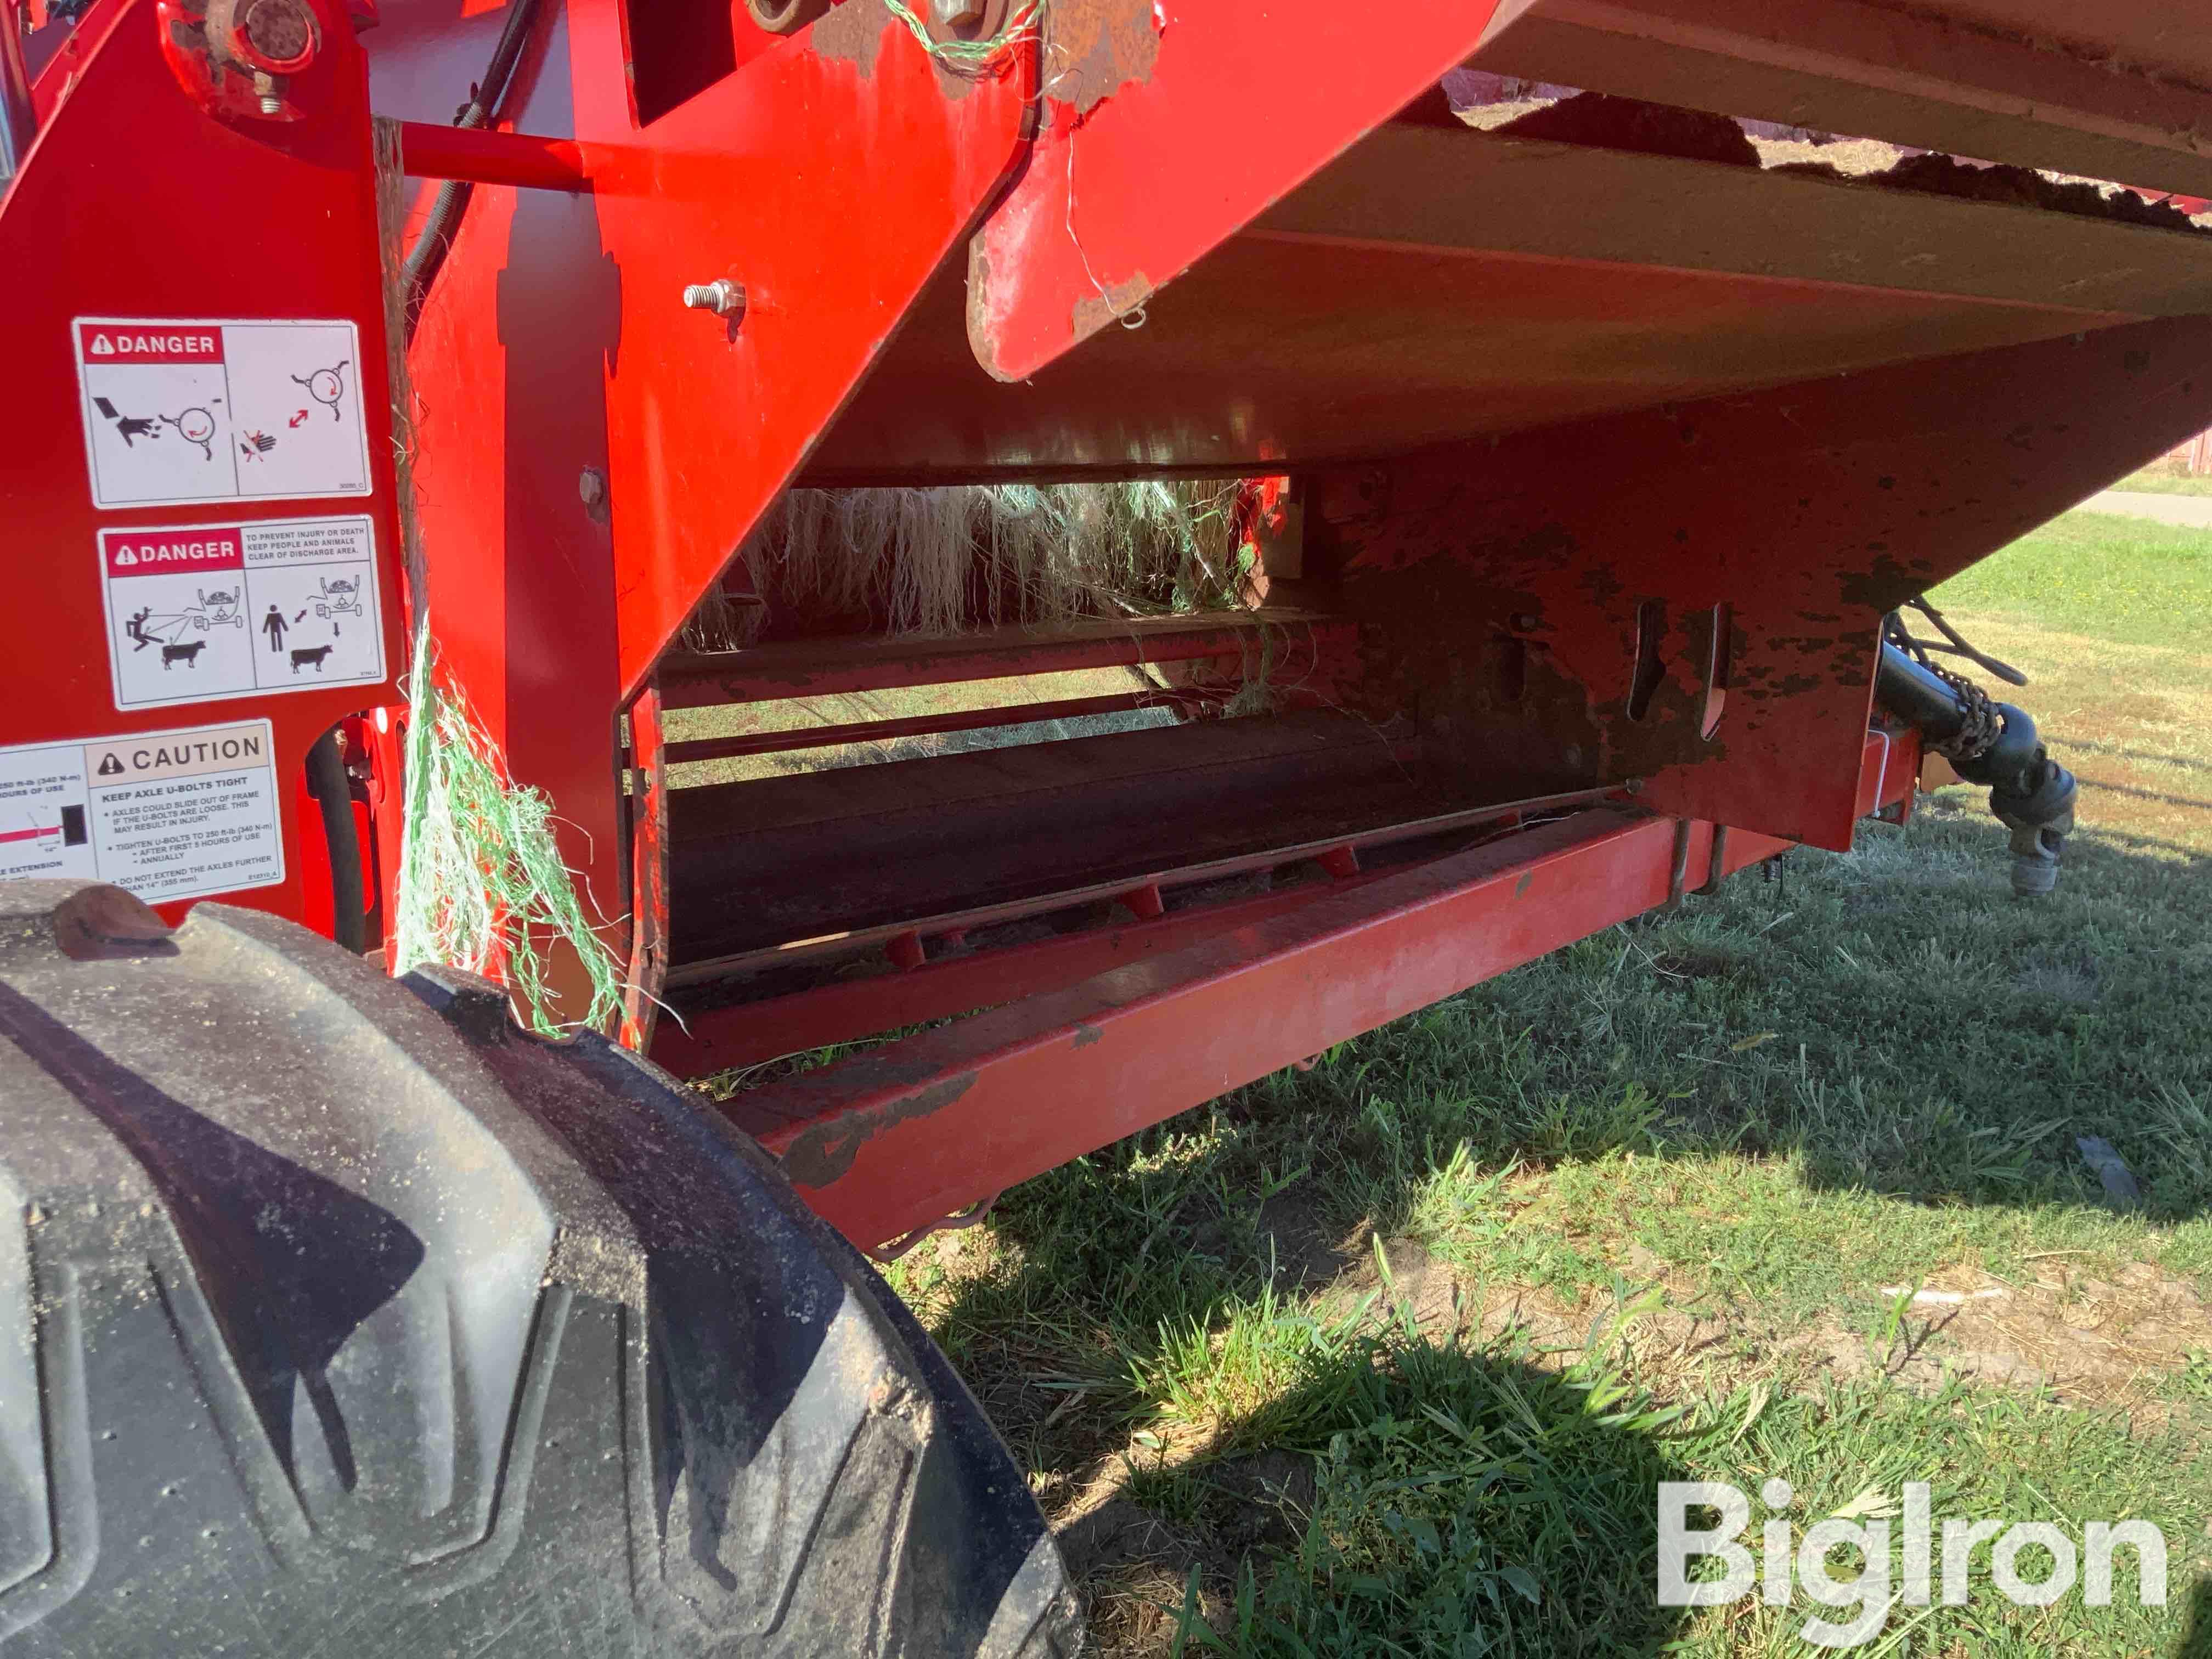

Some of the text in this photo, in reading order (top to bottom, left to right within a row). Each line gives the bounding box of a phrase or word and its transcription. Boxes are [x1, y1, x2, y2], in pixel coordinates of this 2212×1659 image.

[117, 336, 215, 353] DANGER
[247, 543, 268, 551] KEEP
[271, 541, 301, 550] PEOPLE
[322, 538, 355, 546] ANIMALS
[260, 532, 295, 540] PREVENT
[298, 530, 325, 538] INJURY
[140, 541, 235, 562] DANGER
[249, 552, 274, 561] CLEAR
[290, 549, 334, 558] DISCHARGE
[133, 737, 260, 770] CAUTION
[0, 789, 27, 798] OURS
[102, 777, 248, 803] KEEP AXLE U-BOLTS TIGHT
[112, 807, 141, 816] AXLES
[143, 803, 172, 812] COULD
[174, 799, 198, 808] SLIDE
[200, 797, 217, 805] OUT
[232, 791, 259, 800] FRAME
[123, 816, 140, 824] THE
[142, 810, 178, 821] U-BOLTS
[199, 804, 229, 814] LOOSE.
[231, 801, 249, 809] THIS
[114, 825, 132, 834] MAY
[135, 821, 167, 831] RESULT
[180, 815, 210, 825] INJURY.
[115, 840, 153, 851] TIGHTEN
[155, 834, 190, 845] U-BOLTS
[238, 826, 253, 834] (340
[140, 847, 167, 856] AFTER
[169, 842, 192, 851] FIRST
[201, 837, 230, 847] HOURS
[245, 833, 261, 841] USE
[10, 861, 63, 874] EXTENSION
[140, 852, 185, 865] ANNUALLY
[134, 874, 152, 883] NOT
[154, 868, 187, 879] EXTEND
[189, 865, 206, 873] THE
[207, 861, 233, 871] AXLES
[235, 855, 272, 867] FURTHER
[161, 879, 178, 887] (355
